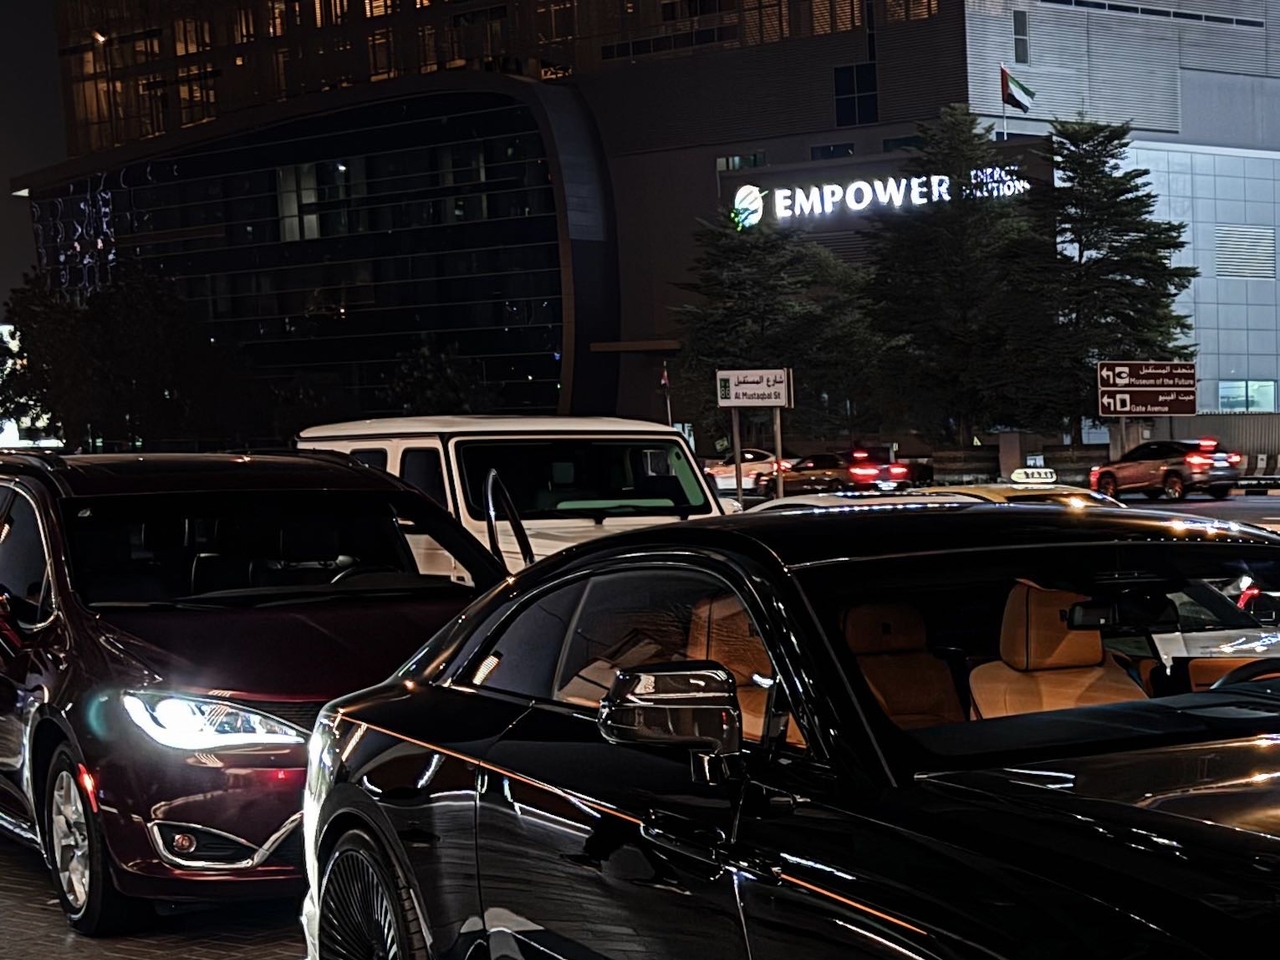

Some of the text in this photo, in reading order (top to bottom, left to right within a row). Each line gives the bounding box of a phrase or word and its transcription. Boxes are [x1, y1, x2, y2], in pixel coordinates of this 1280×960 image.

[774, 175, 951, 219] EMPOWER
[1139, 365, 1171, 375] المستقبل
[734, 374, 764, 387] المستقبل
[766, 374, 784, 387] شارع
[1130, 377, 1194, 385] Museum of the Future
[742, 391, 773, 401] Mustaqbal
[773, 391, 781, 400] St
[1131, 404, 1169, 412] Gate Avenue
